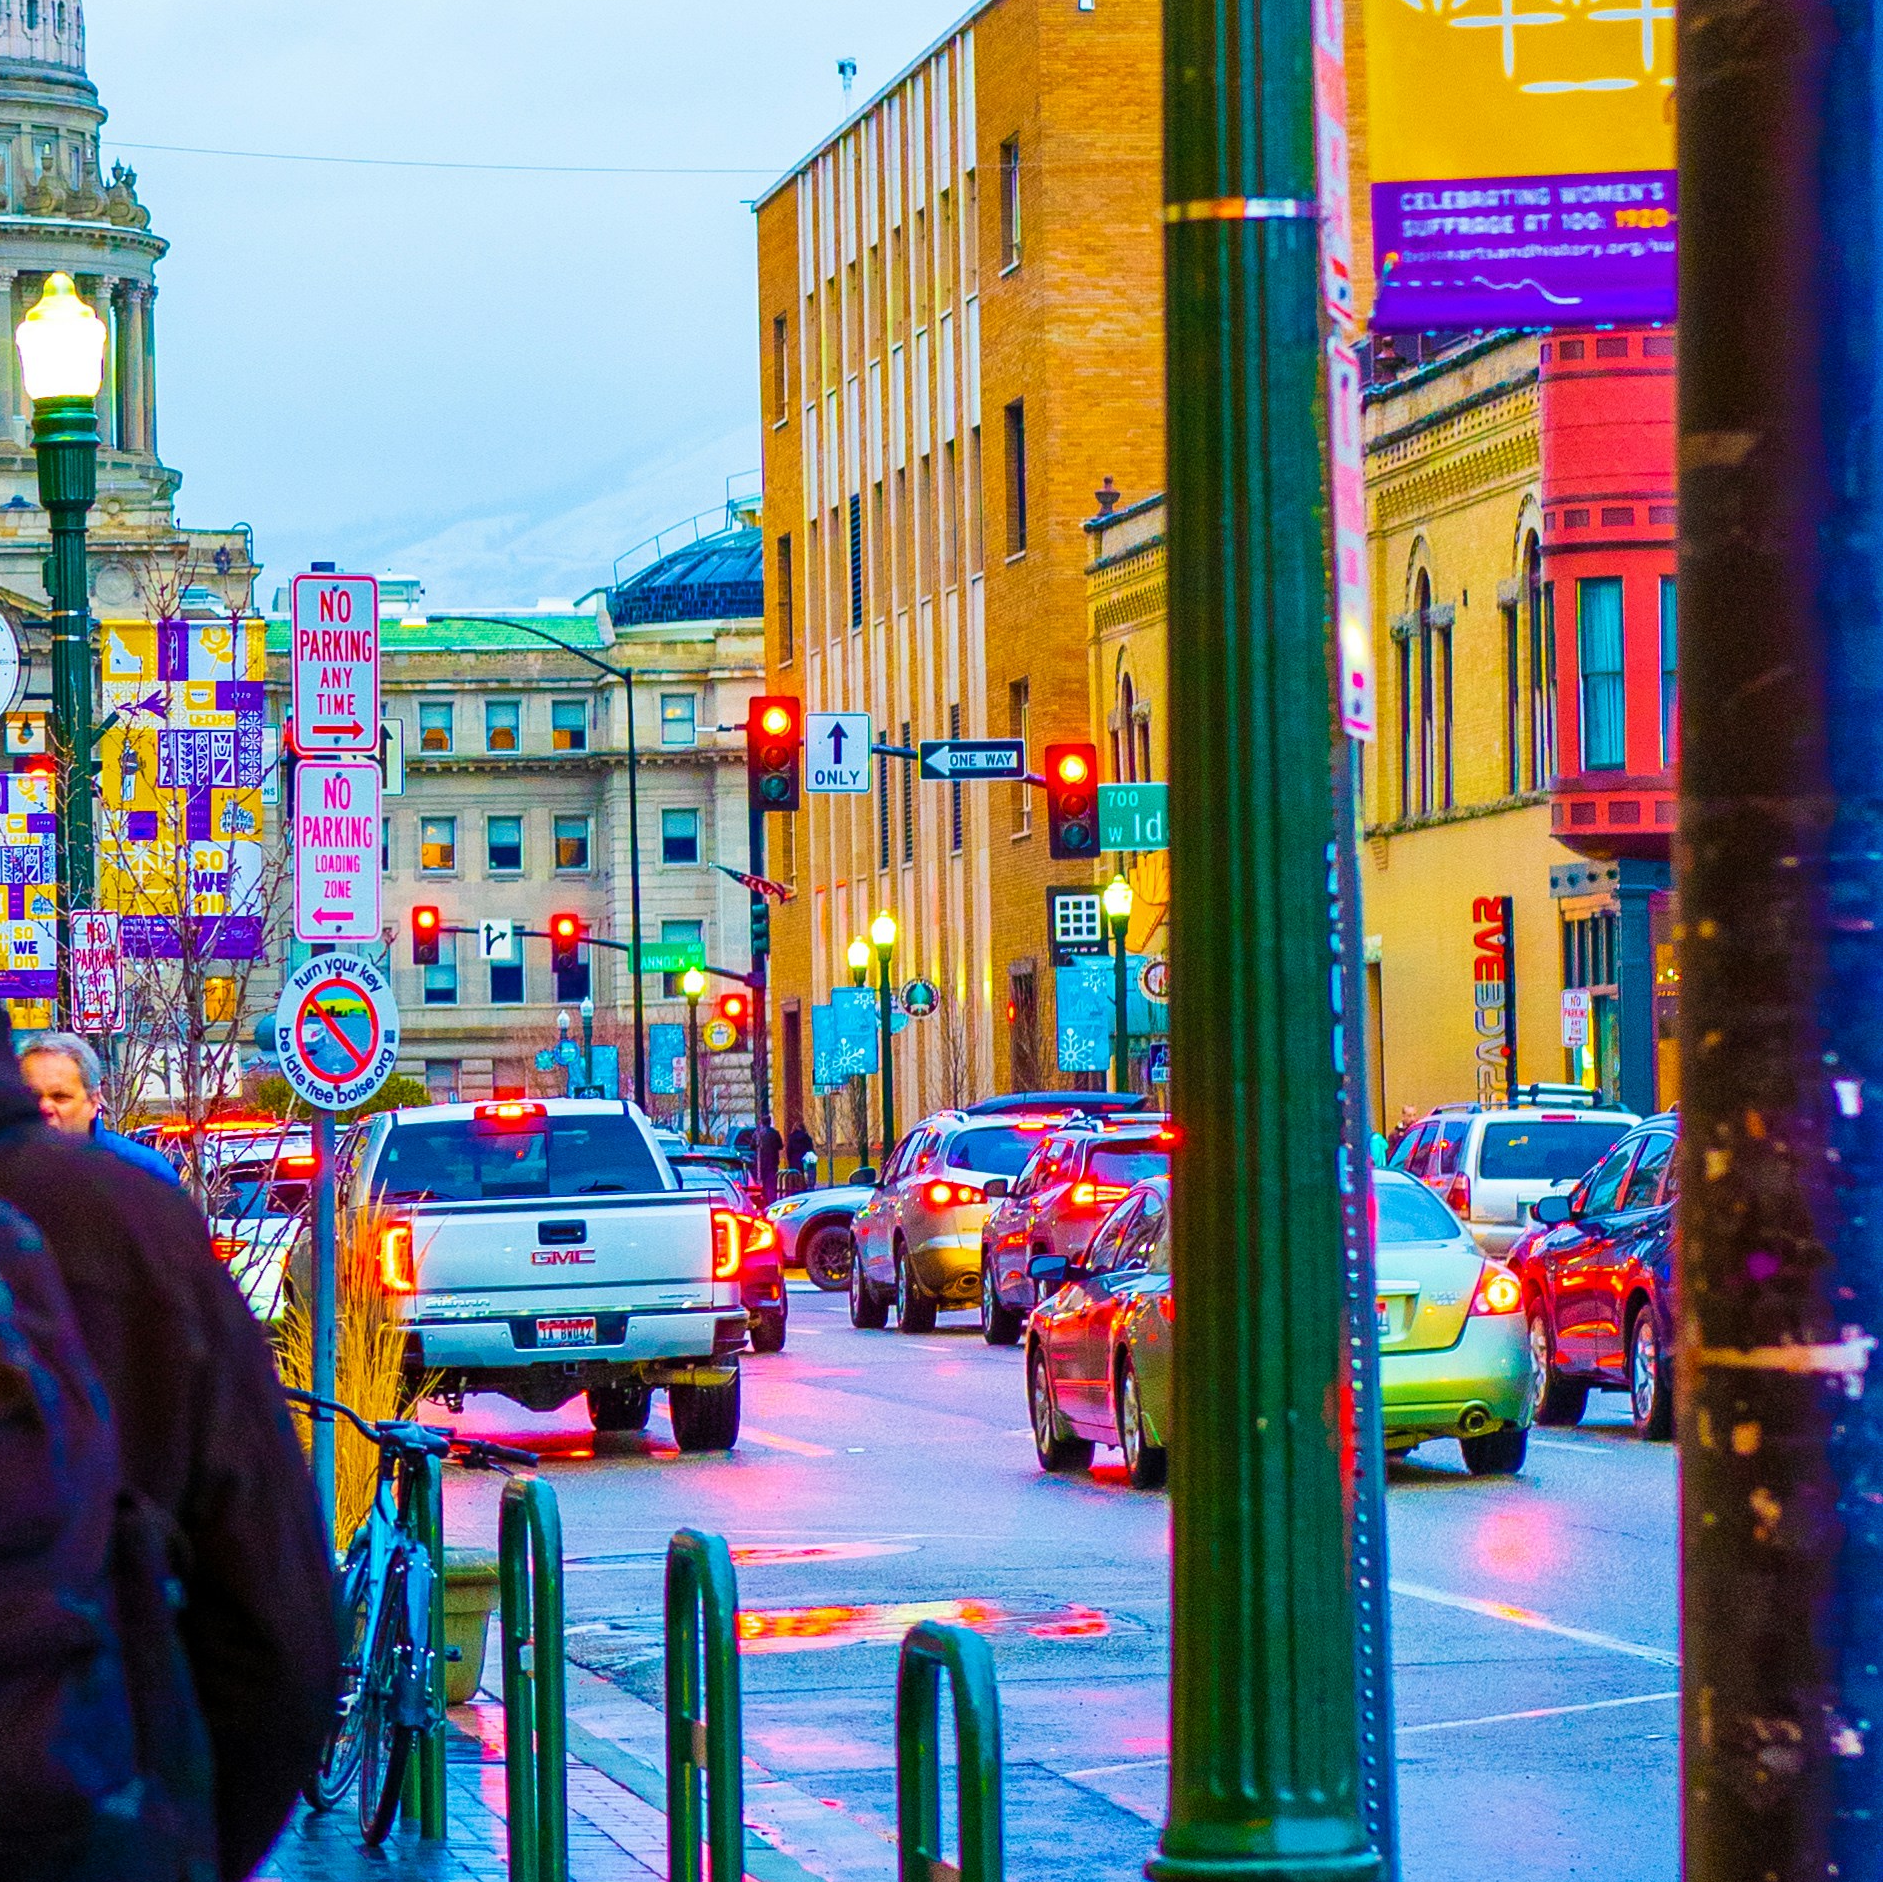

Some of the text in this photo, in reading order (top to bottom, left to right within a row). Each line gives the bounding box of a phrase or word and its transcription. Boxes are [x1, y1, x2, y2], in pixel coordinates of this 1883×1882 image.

[1400, 182, 1664, 211] CELEBRATING WOMEN'S
[1402, 215, 1515, 238] SUFFRAGE
[1523, 213, 1552, 232] AT
[1561, 211, 1607, 230] 100:
[320, 590, 351, 623] NO
[300, 629, 372, 662] PARKING
[320, 667, 352, 688] ANY
[316, 694, 356, 715] TIME
[949, 753, 1012, 767] ONE WAY
[815, 770, 860, 785] ONLY
[324, 778, 351, 810] NO
[1107, 791, 1139, 807] 700
[303, 816, 373, 848] PARKING
[1108, 827, 1123, 843] W
[195, 850, 224, 871] SO
[315, 855, 360, 873] LOADING
[193, 872, 228, 893] WE
[324, 881, 351, 898] ZONE
[14, 926, 33, 940] SO
[87, 922, 107, 944] NO
[13, 941, 39, 954] WE
[14, 955, 39, 968] DID
[640, 956, 685, 970] ANNOCK
[294, 958, 383, 993] turn your key
[1571, 996, 1581, 1007] NO
[1563, 1008, 1586, 1018] PARKING
[279, 1027, 395, 1104] be idle free boise.org
[531, 1249, 596, 1266] GMC
[425, 1296, 490, 1309] SIERRA
